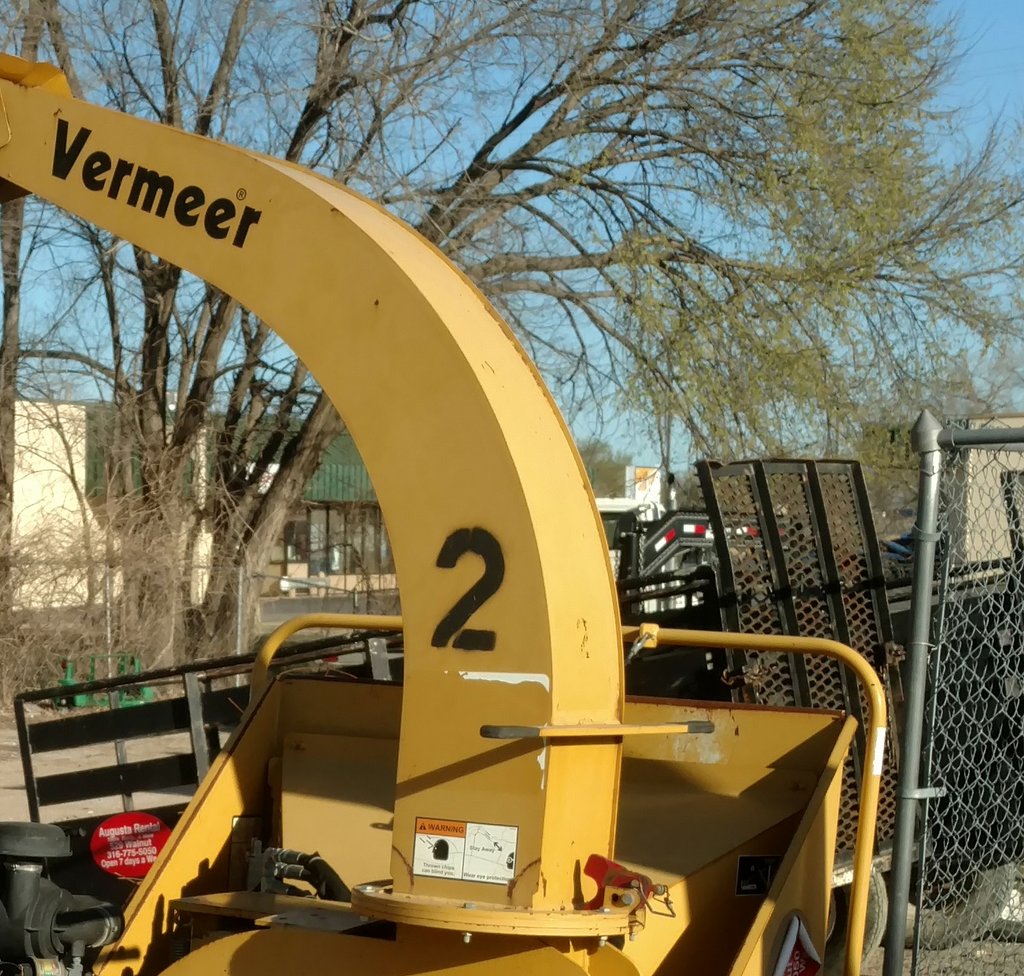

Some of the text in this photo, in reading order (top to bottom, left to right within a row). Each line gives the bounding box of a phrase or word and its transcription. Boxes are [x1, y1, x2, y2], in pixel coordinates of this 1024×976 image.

[52, 118, 262, 248] Vermeer
[431, 526, 505, 651] 2
[98, 821, 160, 837] Augusta Rental
[428, 823, 464, 834] WARNING
[125, 839, 152, 848] Walnut
[101, 858, 118, 868] Open
[124, 856, 140, 866] days
